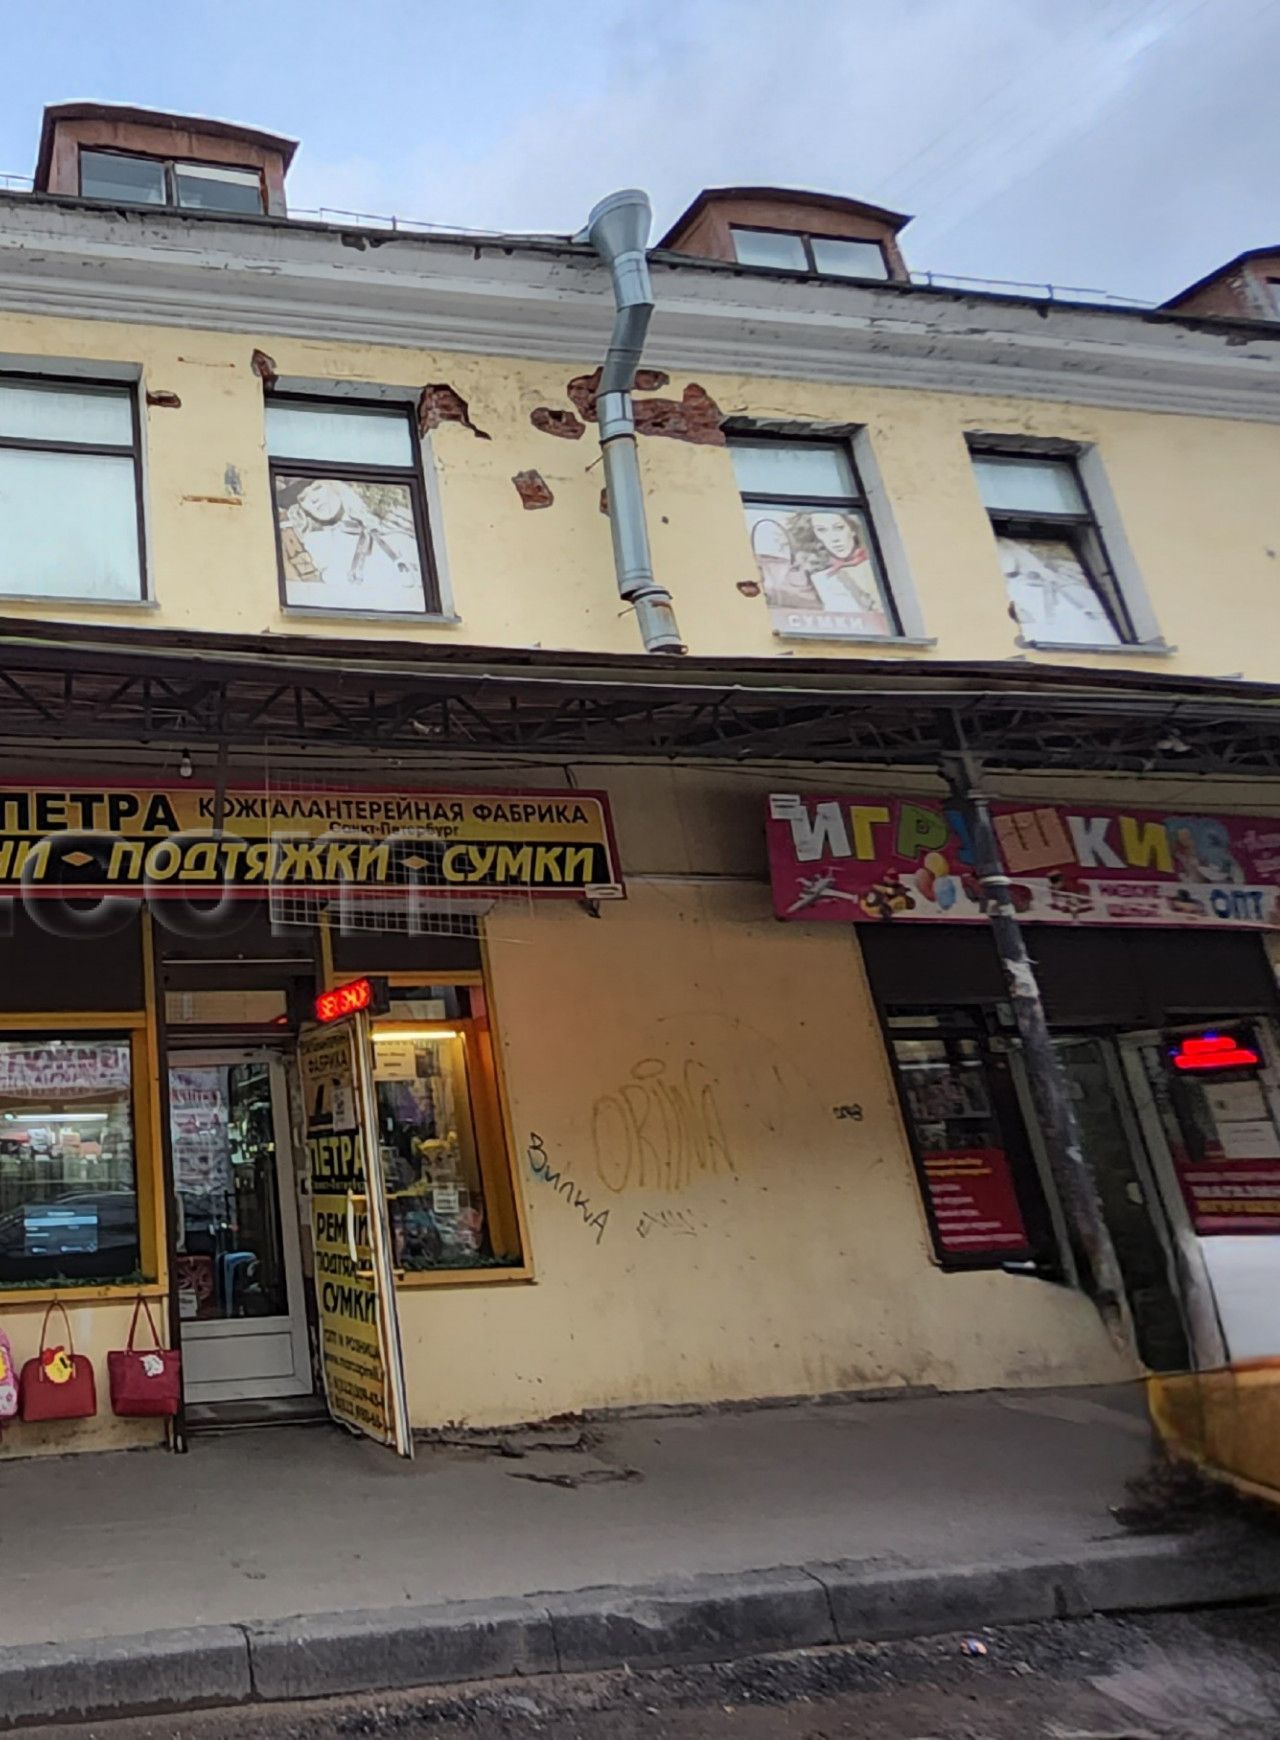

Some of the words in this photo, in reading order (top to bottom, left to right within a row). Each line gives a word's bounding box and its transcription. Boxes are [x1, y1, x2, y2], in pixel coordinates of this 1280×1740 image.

[787, 614, 864, 630] СУМКИ
[198, 798, 464, 822] КОЖГАЛАНТЕРЕЙНАЯ
[472, 802, 589, 825] ФАБРИКА
[106, 842, 390, 881] ПОДТЯЖКИ
[442, 844, 593, 882] СУМКИ
[322, 1282, 377, 1325] СУМКИ
